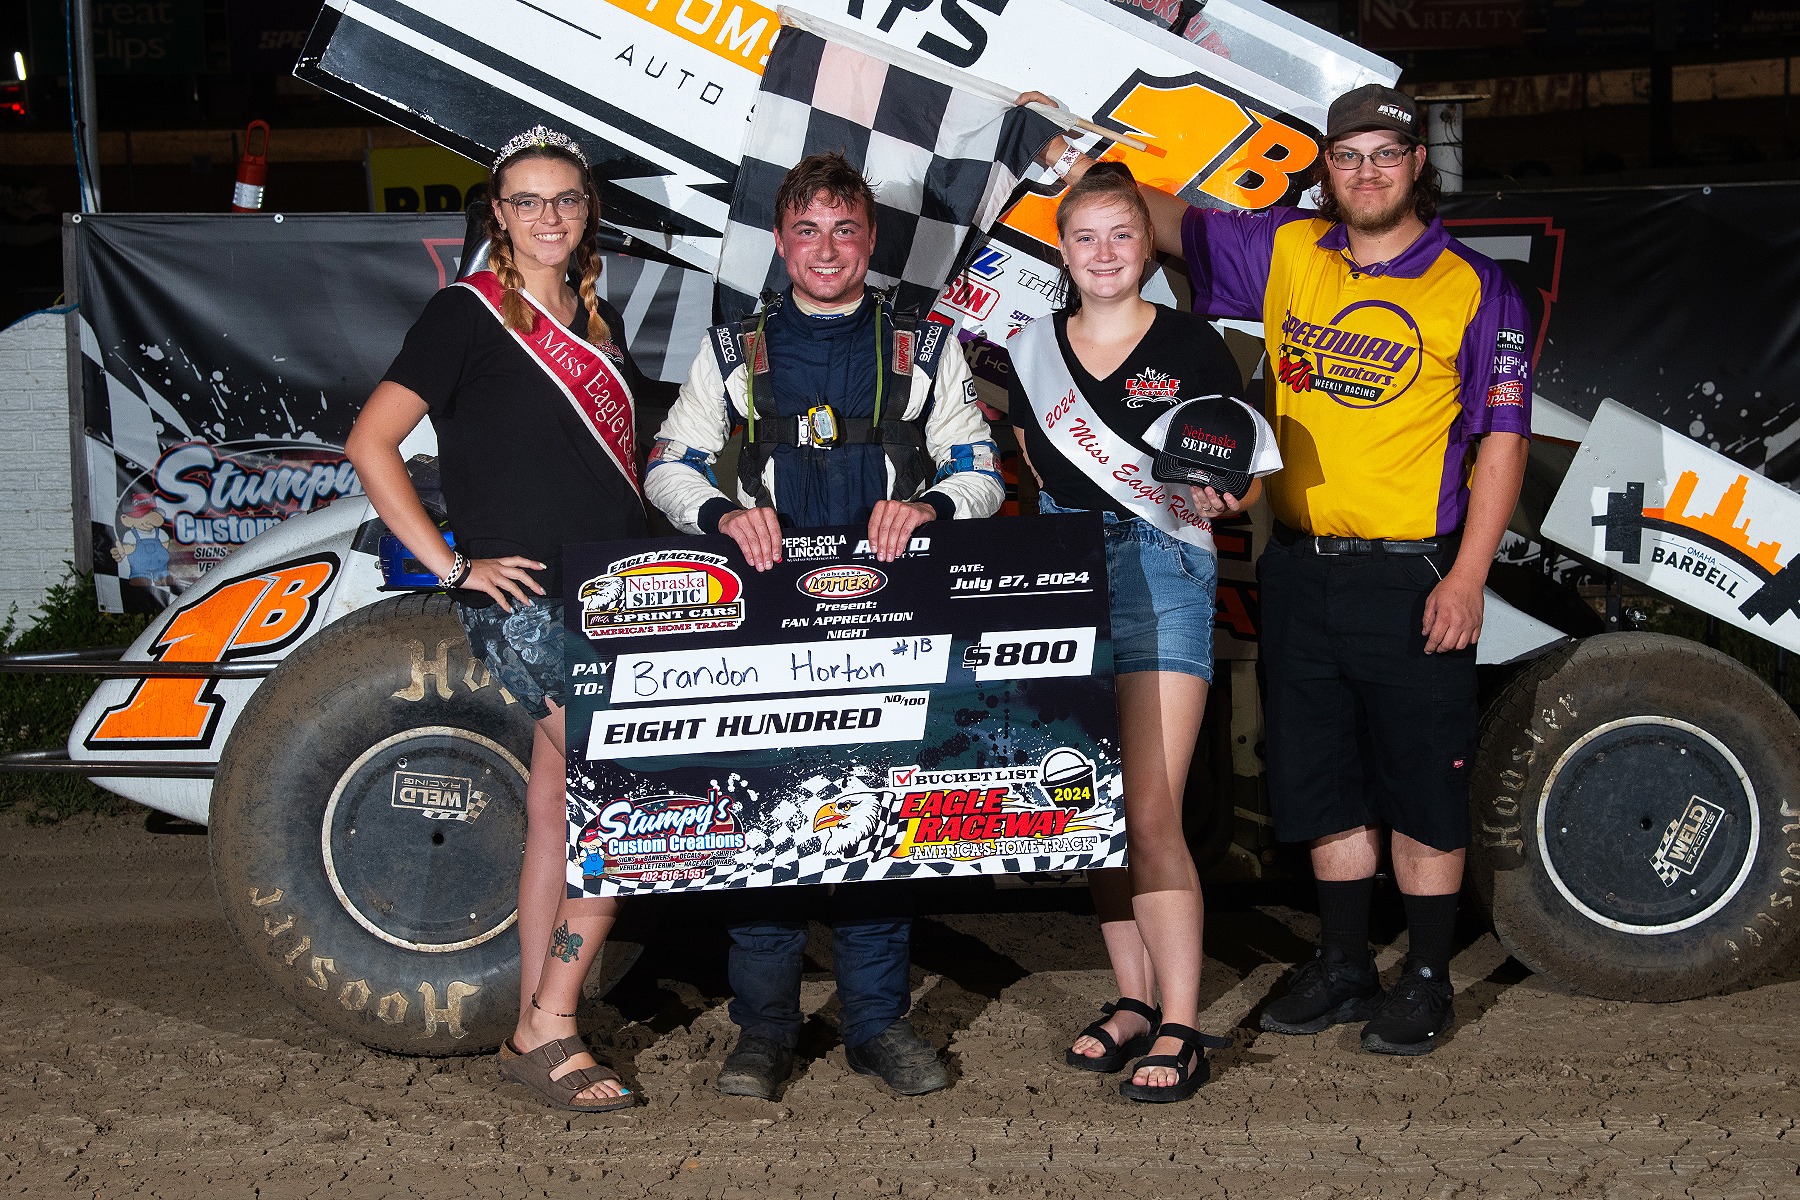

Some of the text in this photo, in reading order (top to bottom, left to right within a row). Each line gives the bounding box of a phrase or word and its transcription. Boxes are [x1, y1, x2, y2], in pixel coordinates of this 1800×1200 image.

[1424, 10, 1522, 30] REALTY
[615, 44, 724, 106] AUTO
[1377, 104, 1411, 122] AVID
[717, 327, 737, 363] sparco
[919, 325, 941, 363] sparco
[1282, 310, 1416, 373] SPEEDWAY
[1497, 331, 1525, 345] PRO
[899, 334, 910, 372] SIMPSON
[536, 329, 588, 378] Miss
[583, 369, 626, 434] Eagle
[1137, 366, 1170, 381] Miss
[1328, 363, 1395, 387] motors
[1126, 379, 1180, 390] EAGLE
[1129, 389, 1177, 397] RACEWAY
[1315, 378, 1376, 399] WEEKLY RACING
[1045, 388, 1077, 430] 2024
[1069, 418, 1110, 465] Miss
[1112, 463, 1166, 504] Eagle
[1182, 424, 1237, 449] Nebraska
[1181, 436, 1232, 460] SEPTIC
[195, 547, 227, 559] SIGNS
[610, 552, 725, 573] EAGLE RACEWAY
[788, 546, 837, 558] LINCOLN
[1687, 546, 1716, 566] OMAHA
[950, 564, 985, 574] DATE:
[1651, 546, 1739, 599] BARBELL
[628, 574, 706, 593] Nebraska
[808, 574, 879, 594] LOTTERY
[950, 571, 1090, 592] July 27, 2024
[632, 588, 701, 608] SEPTIC
[815, 601, 878, 613] Present:
[613, 610, 684, 624] SPRINT
[688, 606, 738, 619] CARS
[781, 612, 914, 629] FAN APPRECIATION
[656, 623, 692, 633] HOME
[826, 628, 870, 640] NIGHT
[86, 555, 338, 747] 1B
[962, 639, 1079, 671] $800
[572, 662, 613, 677] PAY
[632, 637, 934, 697] Brandon Horton #1B
[573, 682, 604, 696] TO:
[603, 707, 883, 746] EIGHT HUNDRED
[402, 777, 462, 790] RACING
[914, 768, 1039, 786] BUCKET LIST
[399, 786, 462, 809] WELD
[899, 786, 1010, 819] EAGLE
[1053, 786, 1092, 802] 2024
[599, 788, 733, 840] Stumpy's
[912, 809, 1077, 844] RACEWAY
[1668, 804, 1708, 861] WELD
[608, 832, 745, 855] Custom Creations
[995, 839, 1042, 856] HOME
[1686, 813, 1716, 865] RACING
[639, 867, 707, 882] 402-616-1551
[247, 885, 484, 1041] Hoosier
